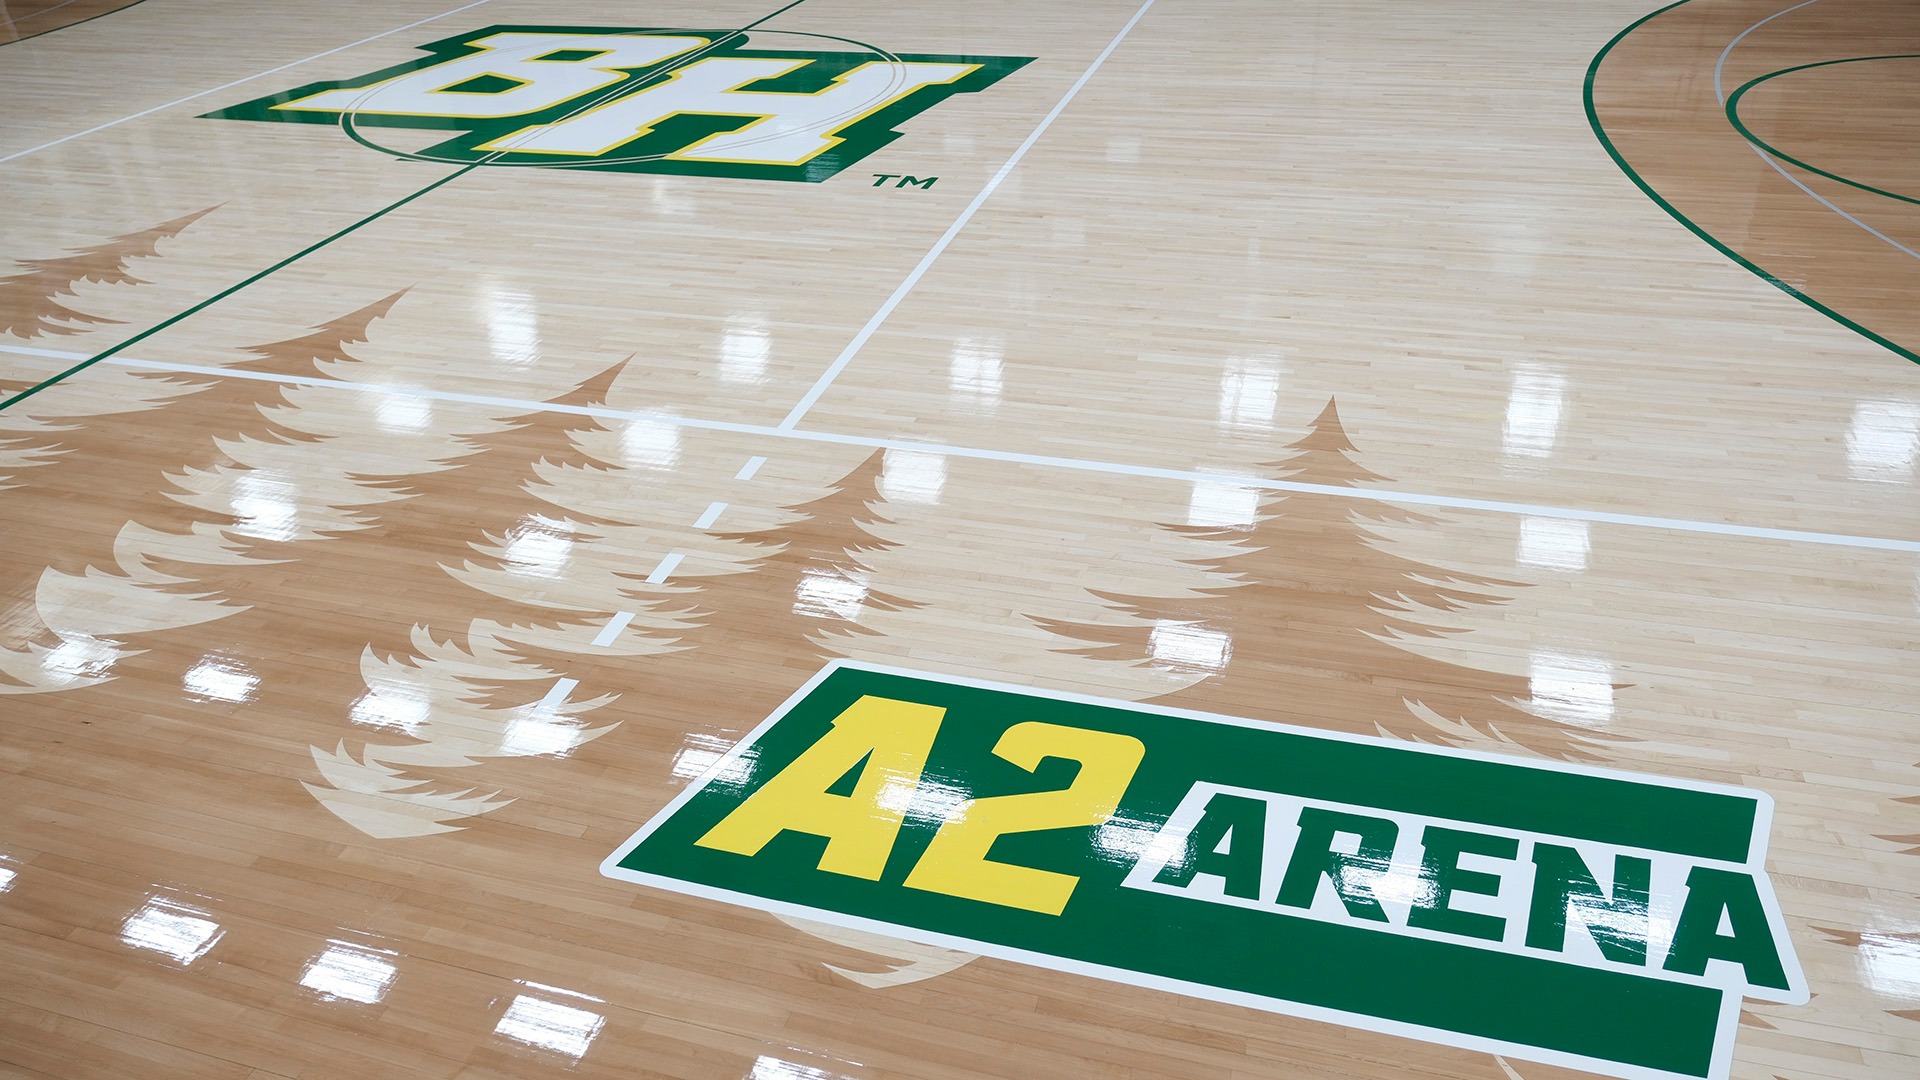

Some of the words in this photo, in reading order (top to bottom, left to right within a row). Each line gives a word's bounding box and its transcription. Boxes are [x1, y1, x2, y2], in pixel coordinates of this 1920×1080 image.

[268, 31, 985, 166] BH
[872, 173, 939, 190] TM
[693, 695, 1146, 917] A2
[1151, 791, 1792, 992] ARENA
